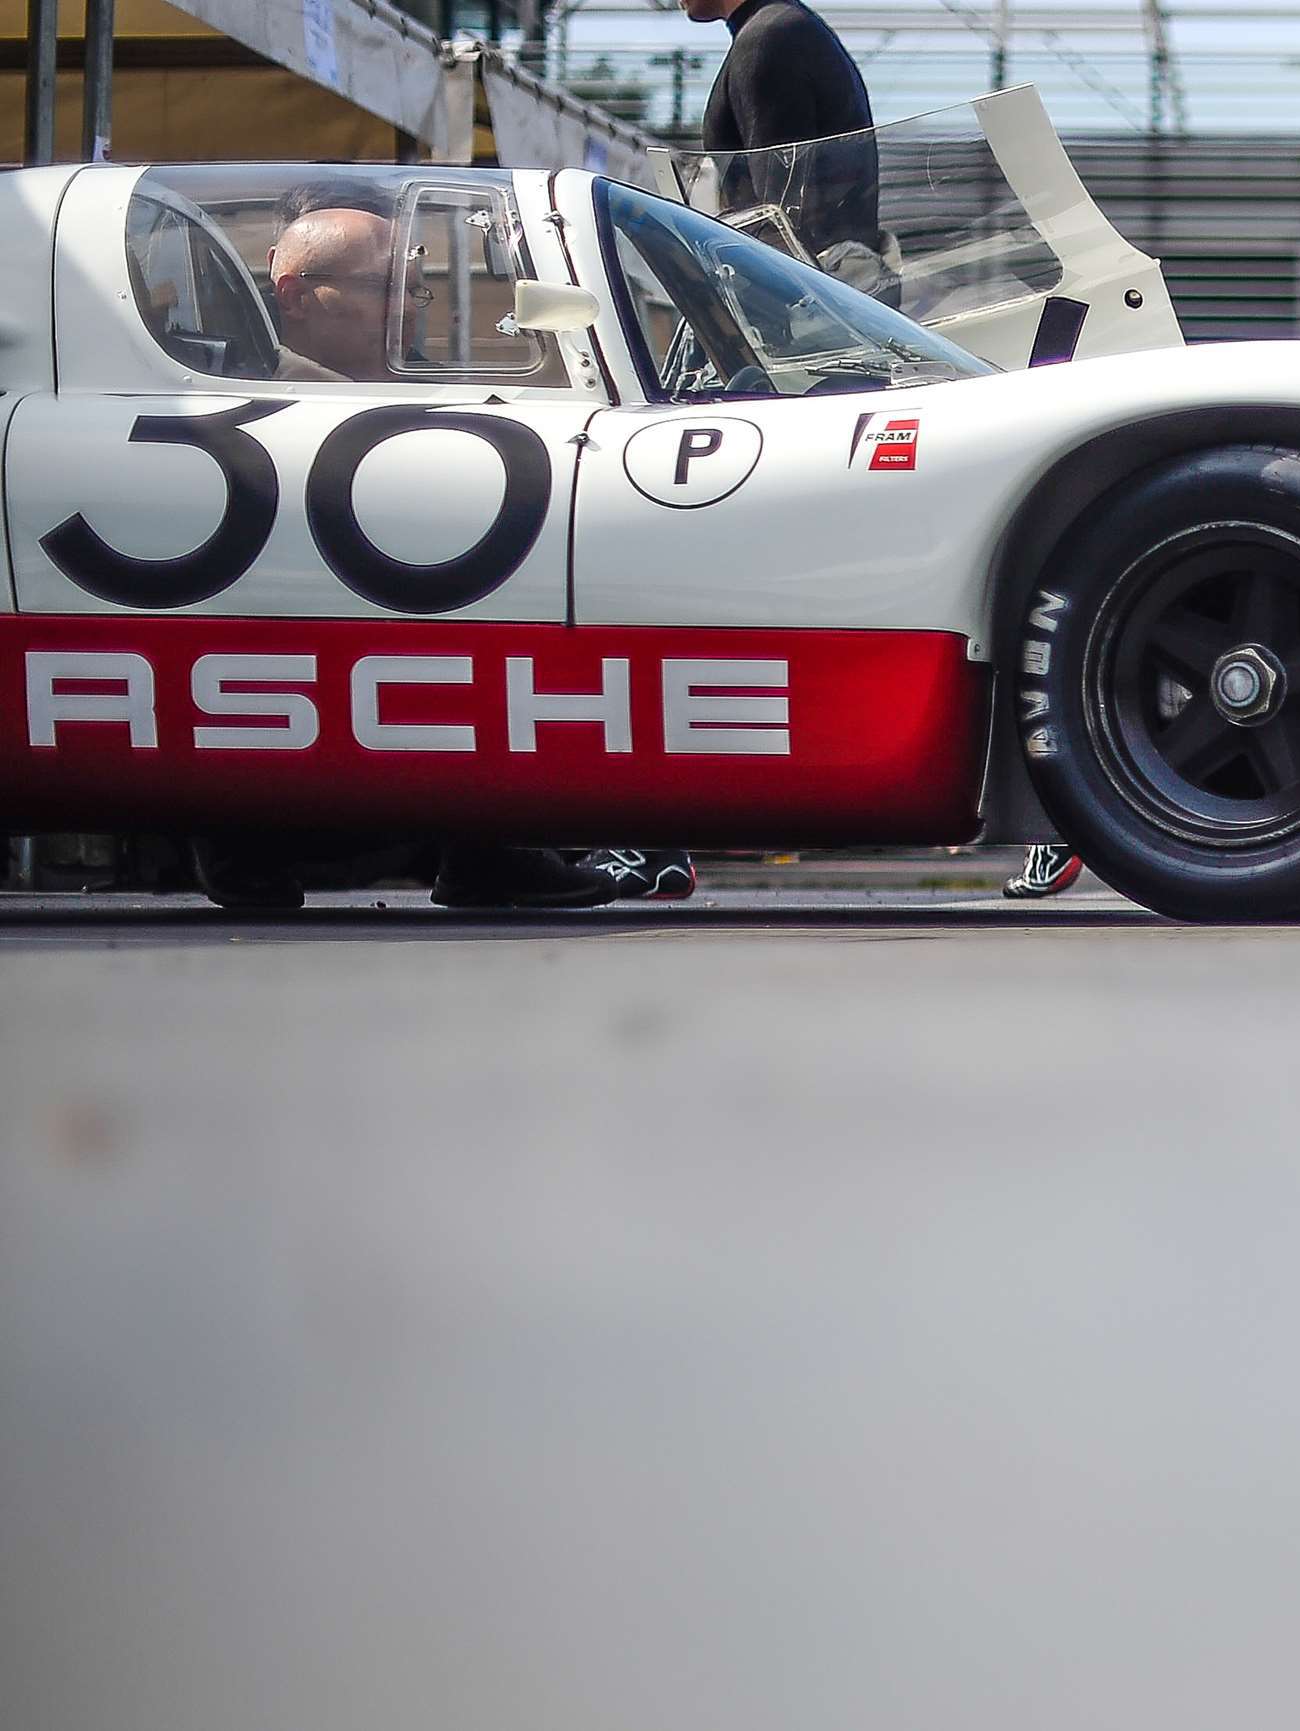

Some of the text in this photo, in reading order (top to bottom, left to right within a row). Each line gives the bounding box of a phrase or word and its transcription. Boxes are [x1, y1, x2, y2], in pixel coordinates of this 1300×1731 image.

[673, 428, 724, 485] P
[865, 432, 912, 441] FRAM
[25, 651, 791, 756] ASCHE
[1020, 590, 1069, 758] AVON
